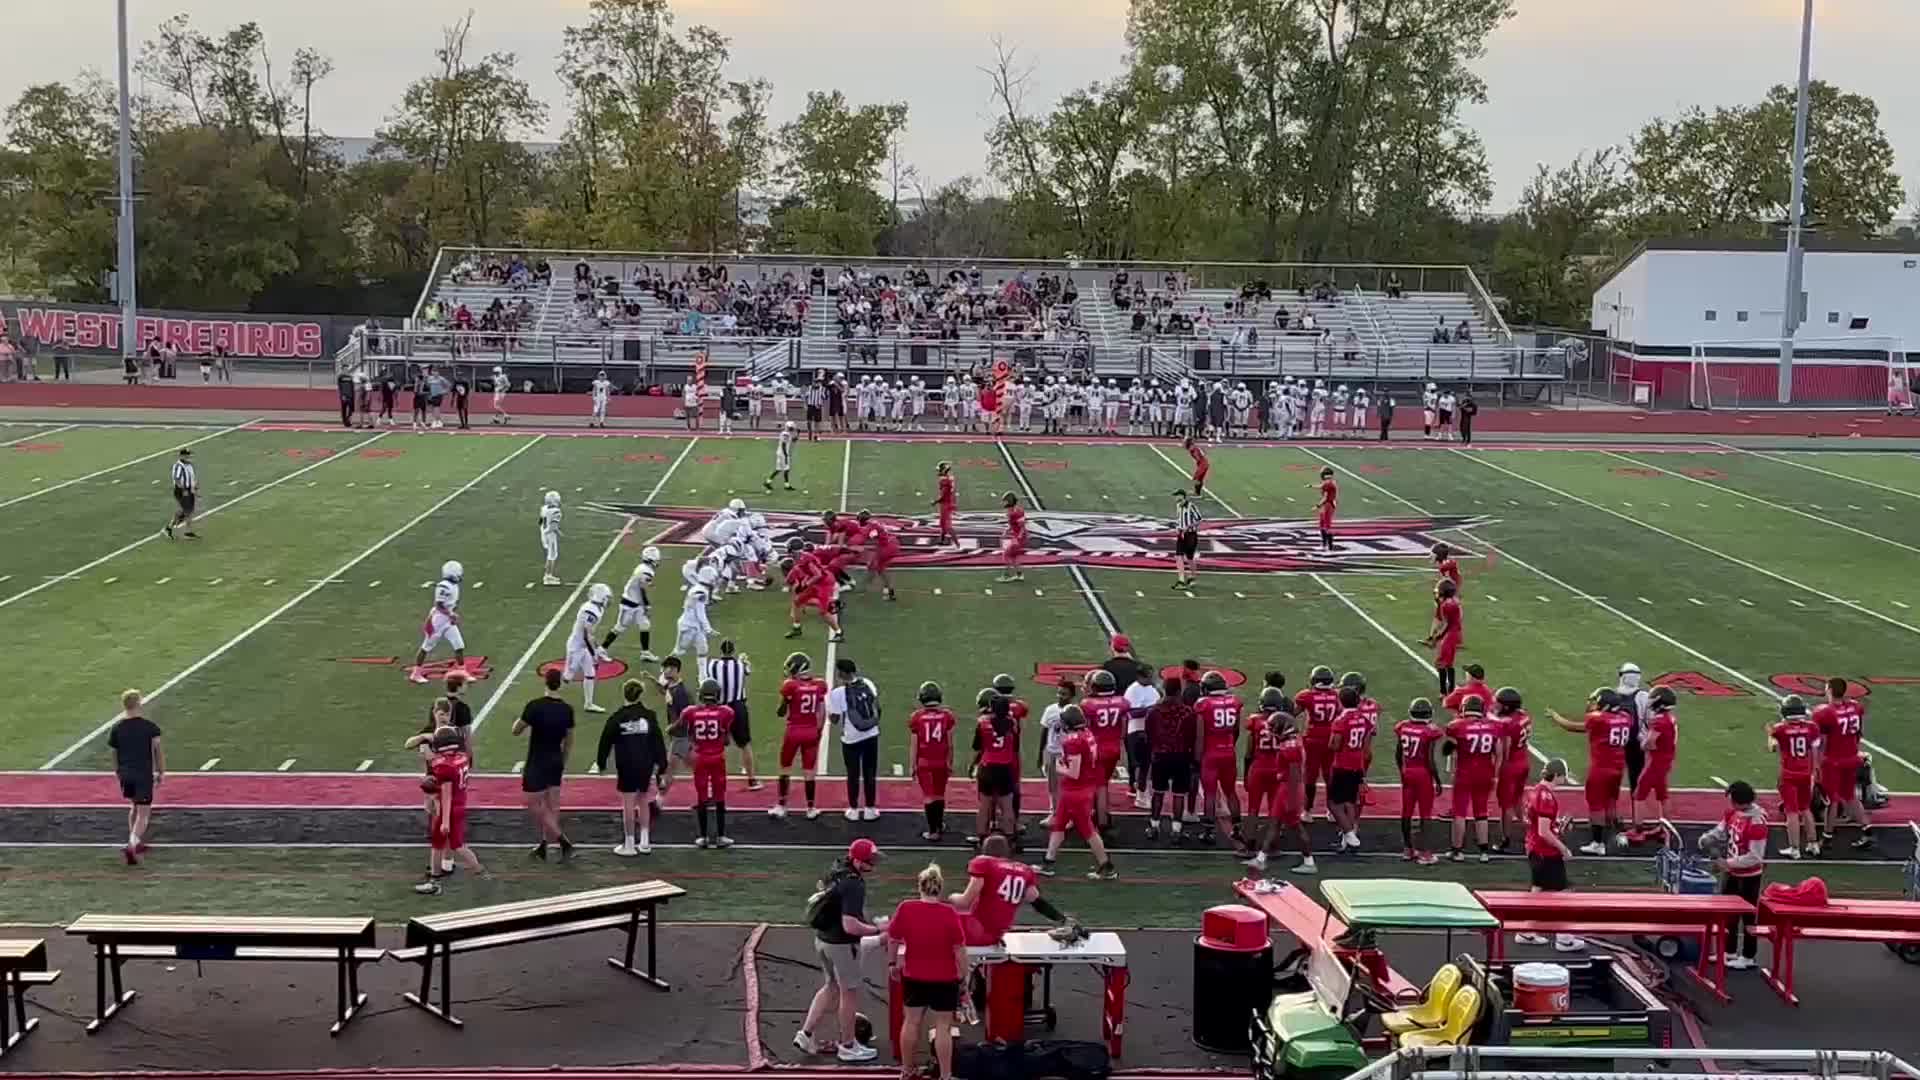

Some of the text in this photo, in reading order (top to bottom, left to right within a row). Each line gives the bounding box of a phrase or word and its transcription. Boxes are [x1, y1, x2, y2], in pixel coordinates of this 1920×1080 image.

[17, 308, 124, 350] WEST
[135, 317, 322, 358] FIREBIRDS
[800, 694, 817, 714] 21
[1314, 703, 1336, 722] 57
[1096, 708, 1120, 728] 37
[1213, 708, 1237, 728] 96
[1837, 714, 1861, 736] 73
[694, 719, 719, 740] 23
[923, 721, 943, 744] 14
[1348, 727, 1366, 748] 87
[1608, 727, 1630, 747] 68
[1401, 735, 1421, 758] 27
[1466, 733, 1494, 754] 78
[1790, 736, 1807, 758] 19
[997, 874, 1026, 905] 40
